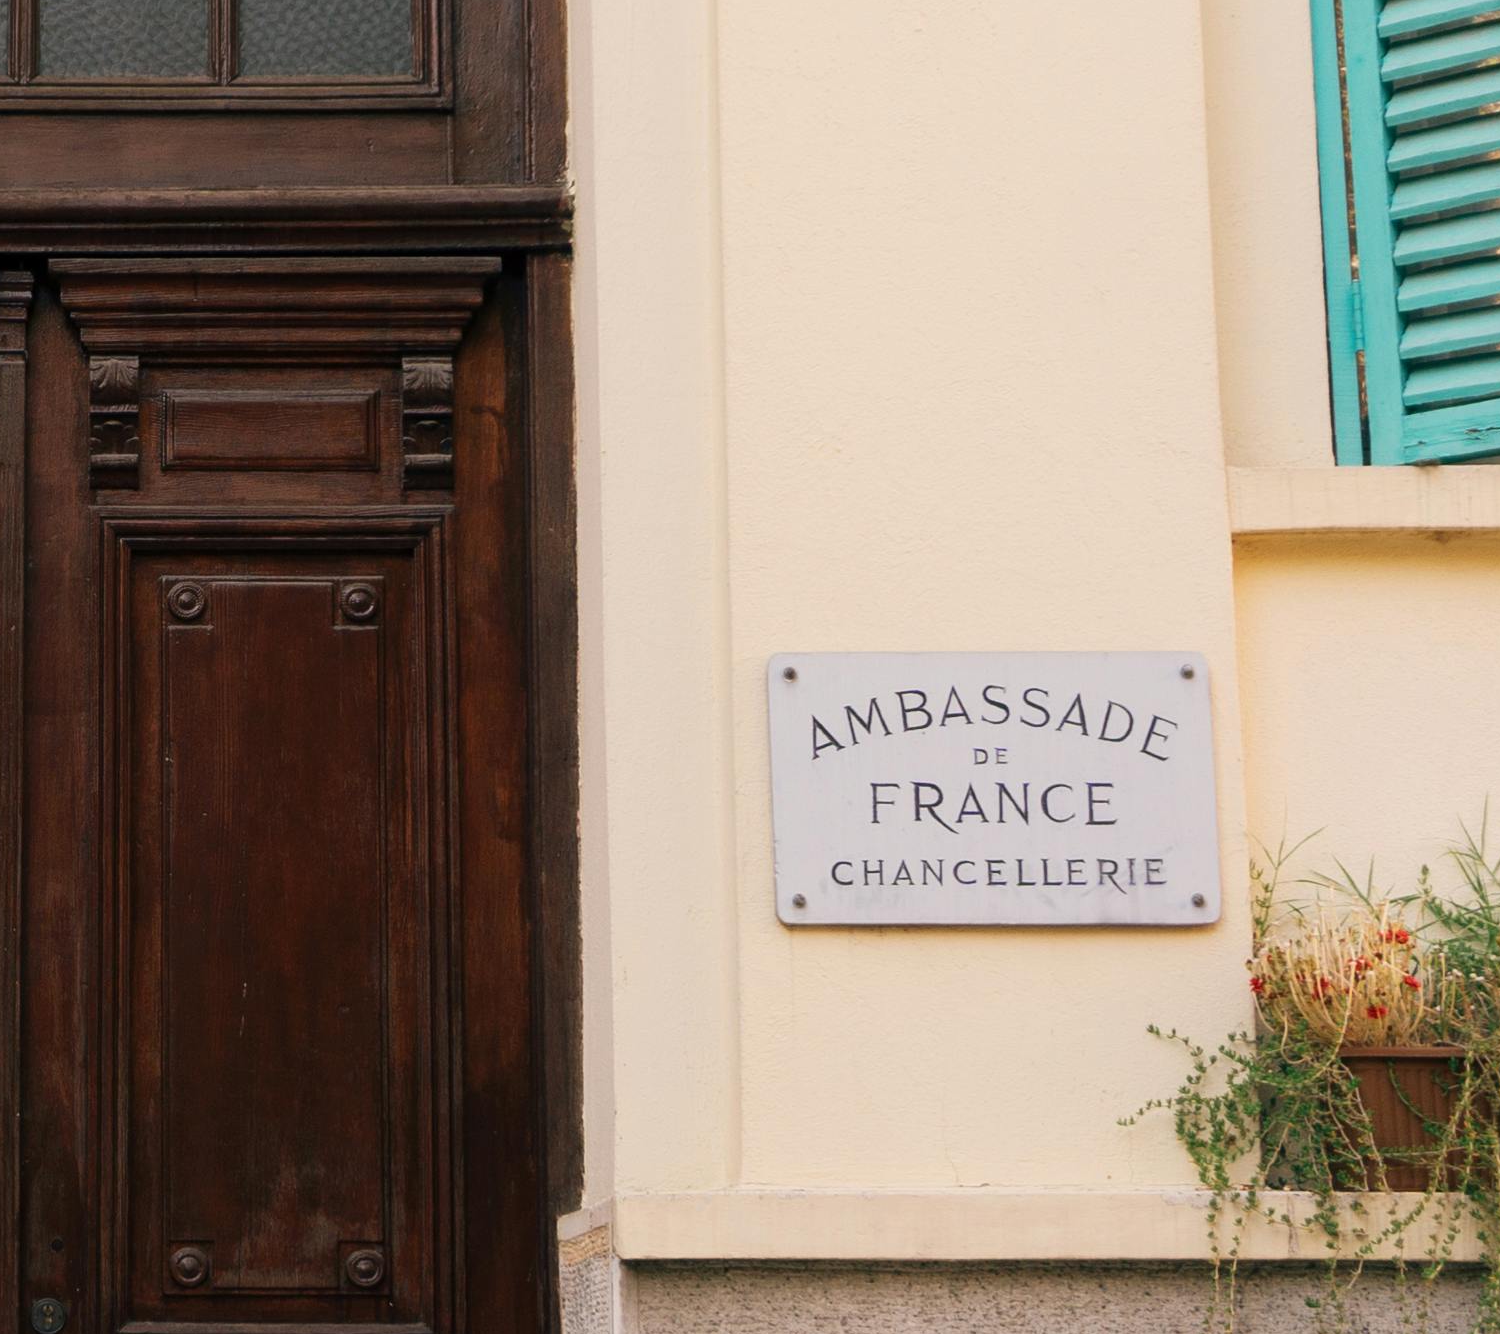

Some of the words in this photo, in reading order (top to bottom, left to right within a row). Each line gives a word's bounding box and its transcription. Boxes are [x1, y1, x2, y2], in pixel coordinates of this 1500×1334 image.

[811, 685, 1179, 762] AMBASSADE
[973, 747, 1009, 765] DE
[870, 781, 1118, 834] FRANCE
[831, 858, 1167, 894] CHANCELLERIE
